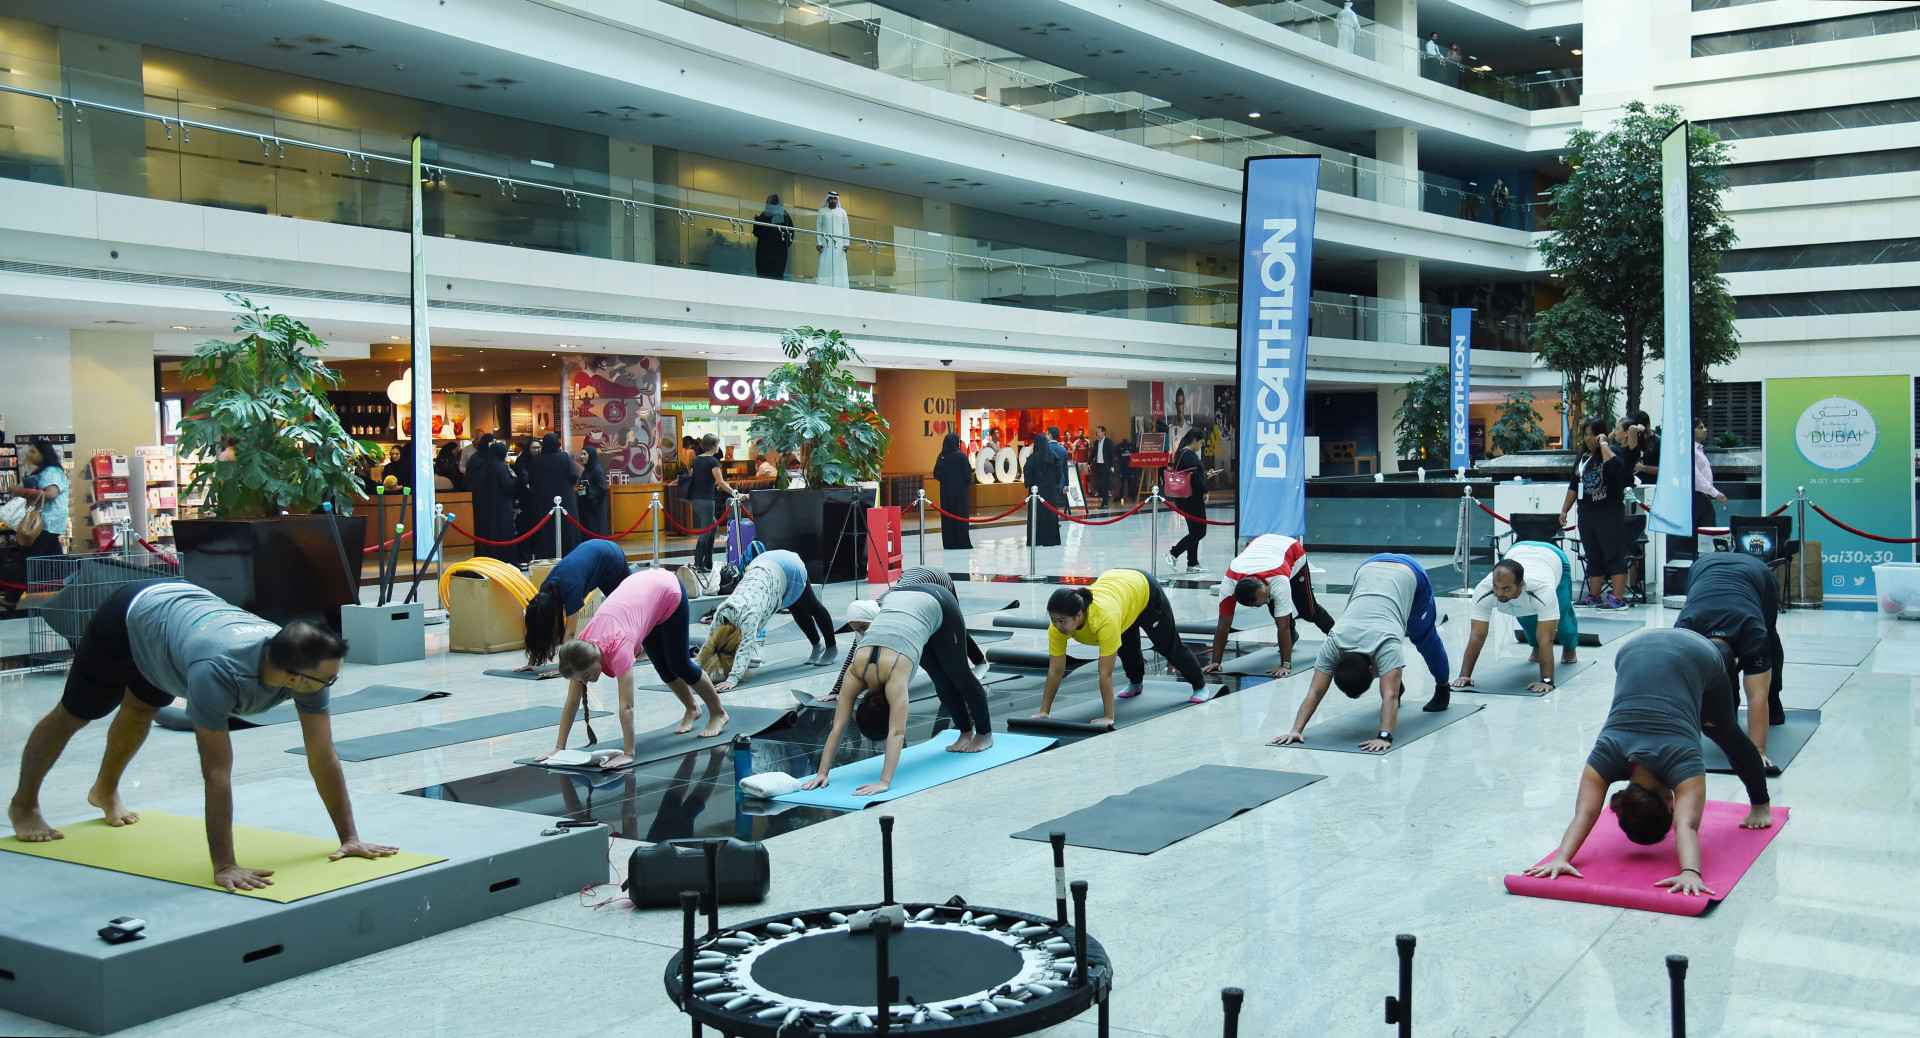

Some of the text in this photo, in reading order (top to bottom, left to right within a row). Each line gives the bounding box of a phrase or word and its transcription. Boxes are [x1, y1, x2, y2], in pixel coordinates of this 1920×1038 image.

[1256, 218, 1297, 479] DECATHLON
[1454, 335, 1466, 455] DECATHLON
[1811, 430, 1861, 444] DUBAI
[1821, 550, 1893, 563] bai30x30
